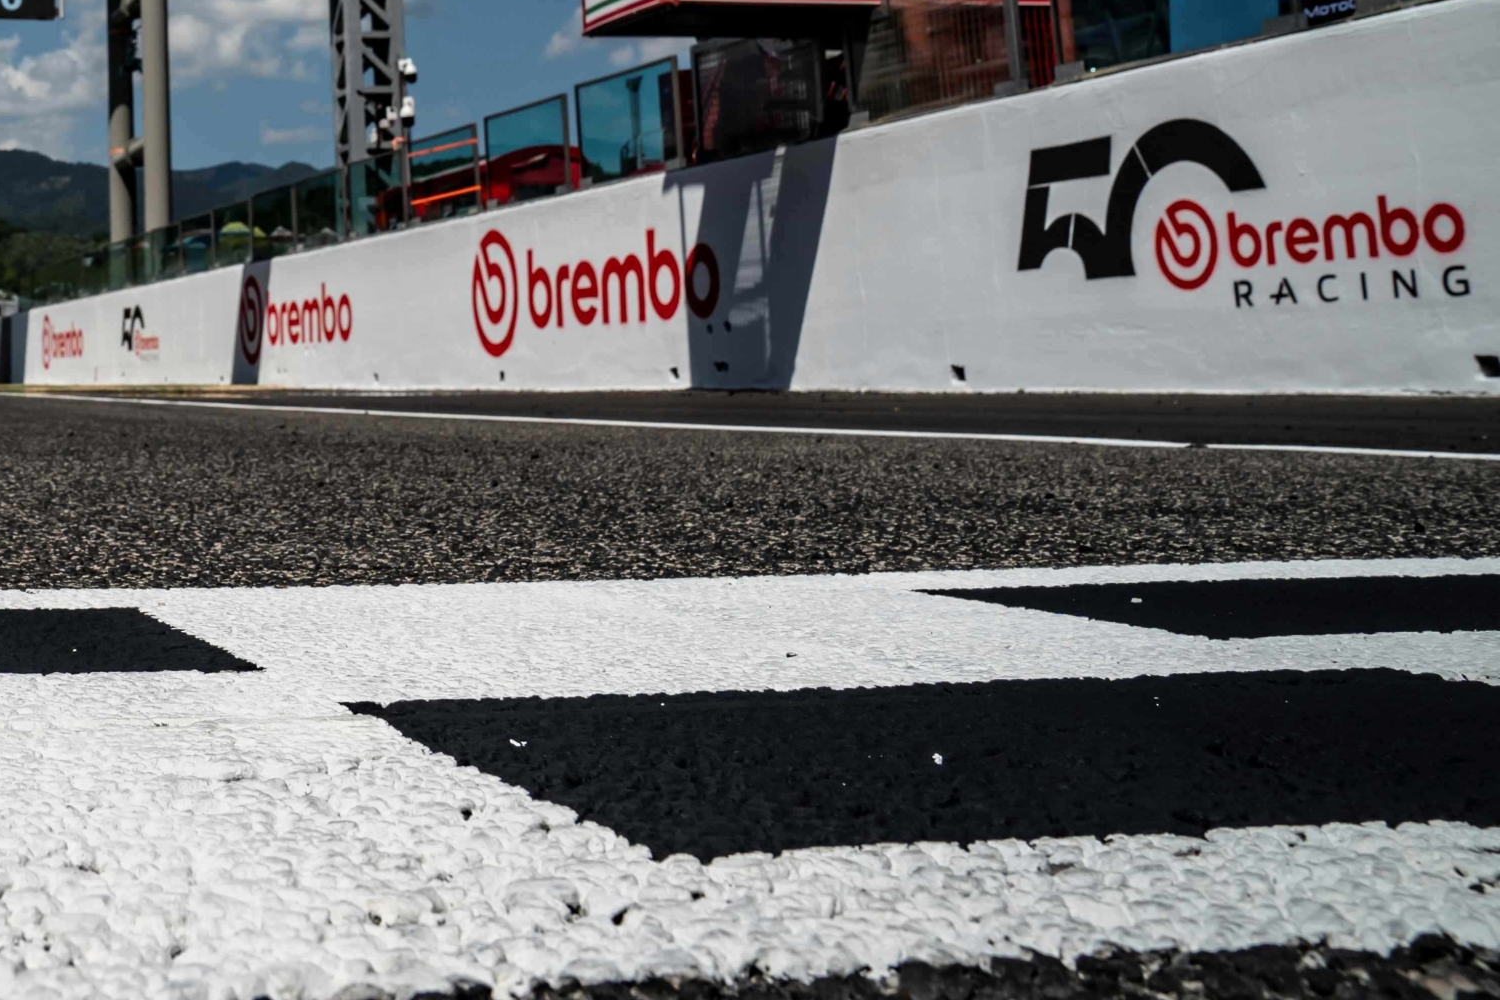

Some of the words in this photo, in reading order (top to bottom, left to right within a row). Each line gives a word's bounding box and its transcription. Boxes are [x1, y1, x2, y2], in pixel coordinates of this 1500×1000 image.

[1226, 194, 1466, 268] brembo
[526, 226, 721, 331] brembo
[1233, 264, 1471, 308] RACING
[266, 282, 354, 347] brembo
